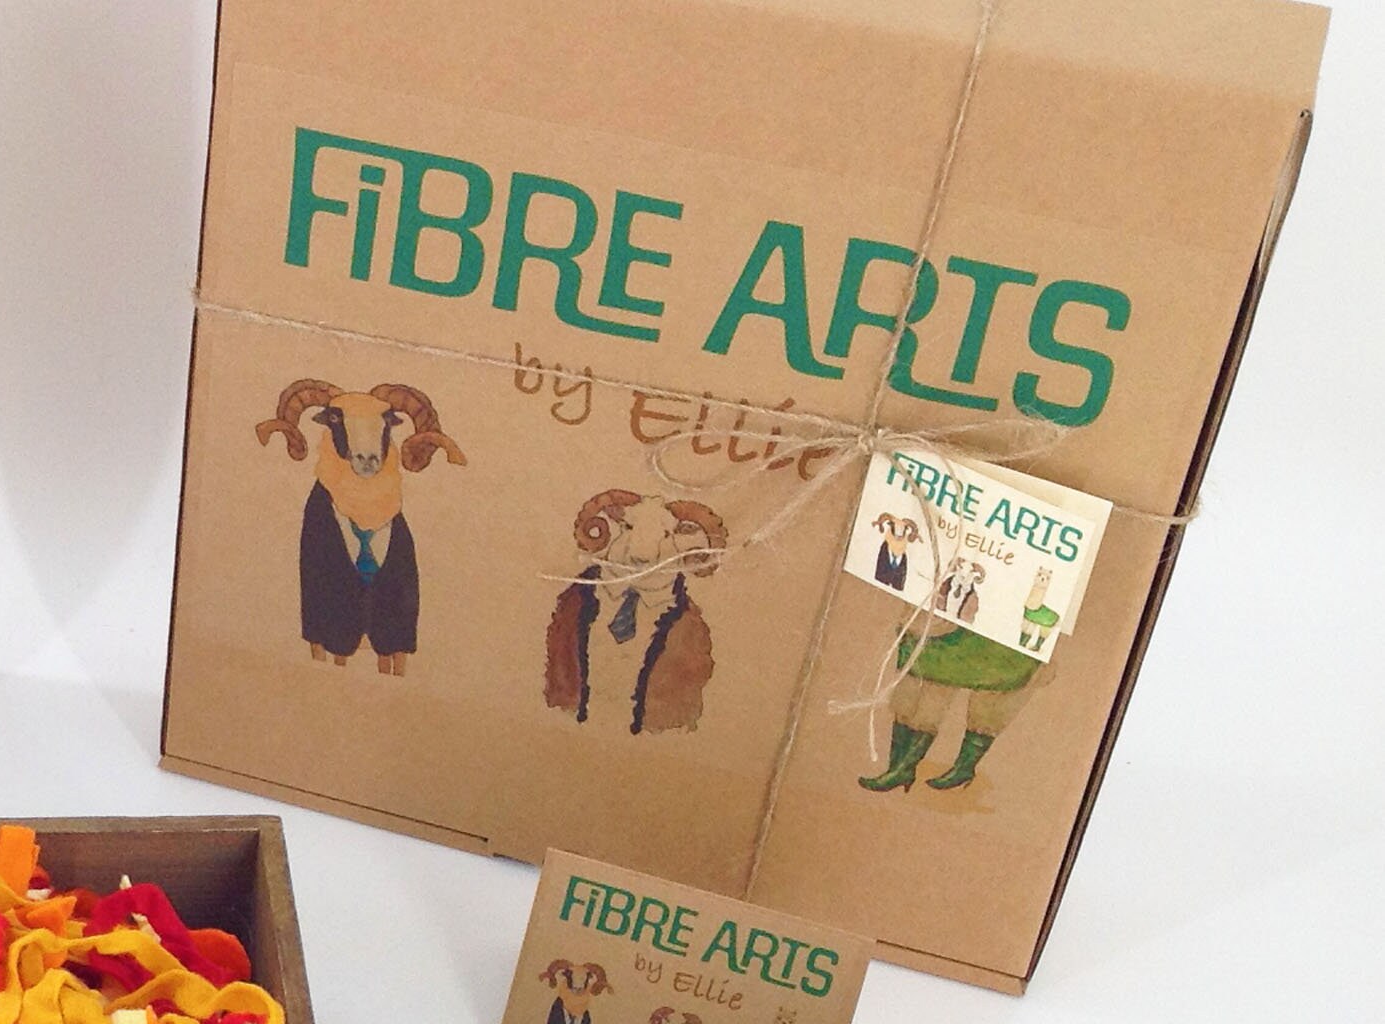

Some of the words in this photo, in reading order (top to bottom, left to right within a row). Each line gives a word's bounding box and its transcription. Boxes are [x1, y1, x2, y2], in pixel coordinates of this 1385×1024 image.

[701, 218, 1133, 428] ARTS
[513, 341, 593, 426] by
[937, 514, 958, 540] by
[965, 531, 1015, 567] Ellie
[984, 498, 1084, 563] ARTS
[634, 951, 665, 984] by
[672, 971, 744, 1012] Ellie
[700, 919, 840, 998] ARTS
